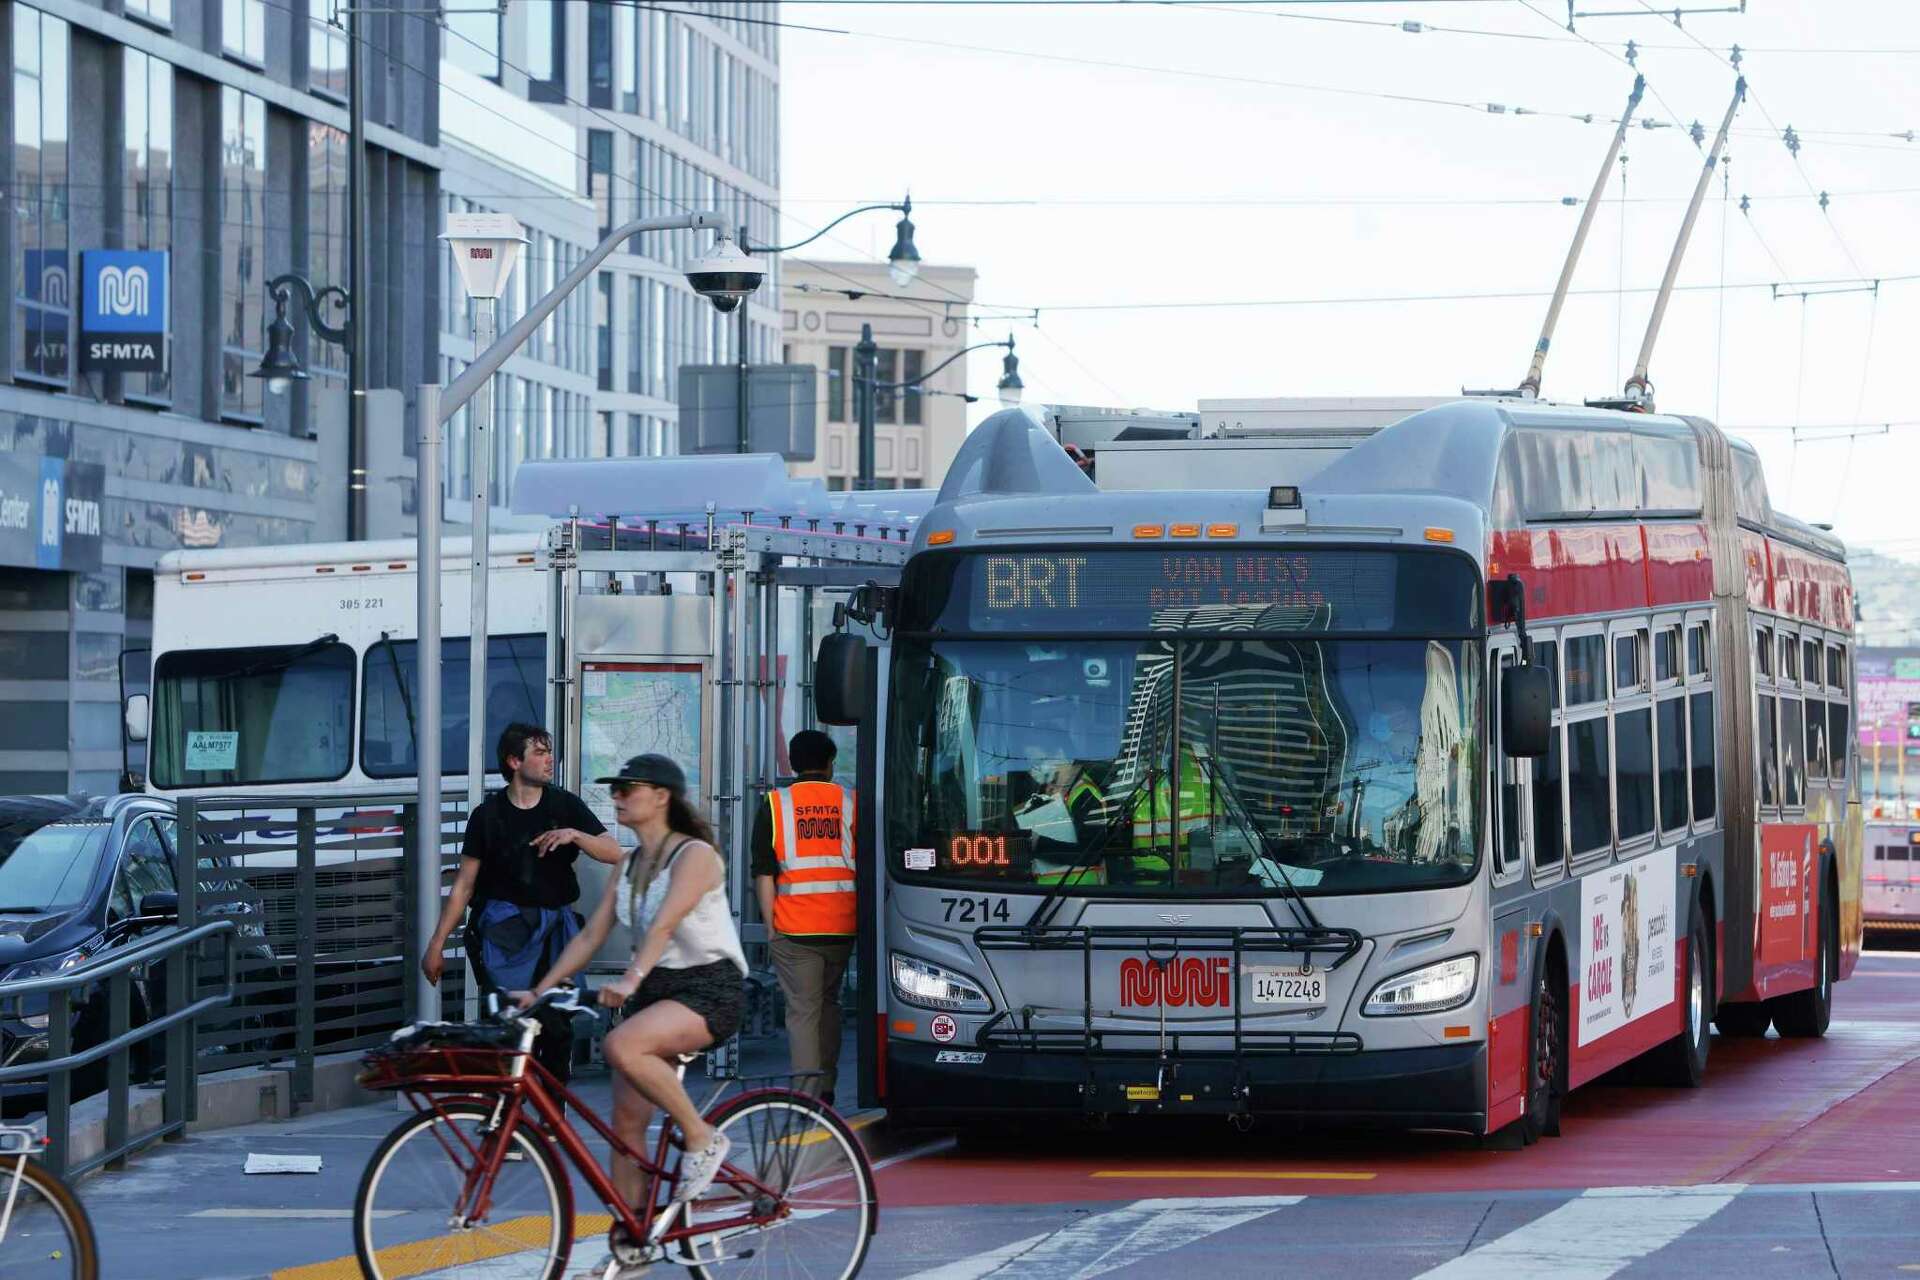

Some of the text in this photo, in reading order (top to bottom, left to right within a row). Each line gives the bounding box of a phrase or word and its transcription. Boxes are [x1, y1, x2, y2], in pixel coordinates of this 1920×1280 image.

[90, 343, 155, 359] SFMTA
[65, 498, 100, 536] SFMTA
[1162, 557, 1311, 583] VAN NESS
[987, 557, 1087, 608] BRT
[339, 598, 384, 609] 305 221
[795, 805, 840, 816] SFMTA
[951, 836, 1009, 864] 001
[941, 898, 1011, 922] 7214
[1256, 980, 1321, 999] 1472248
